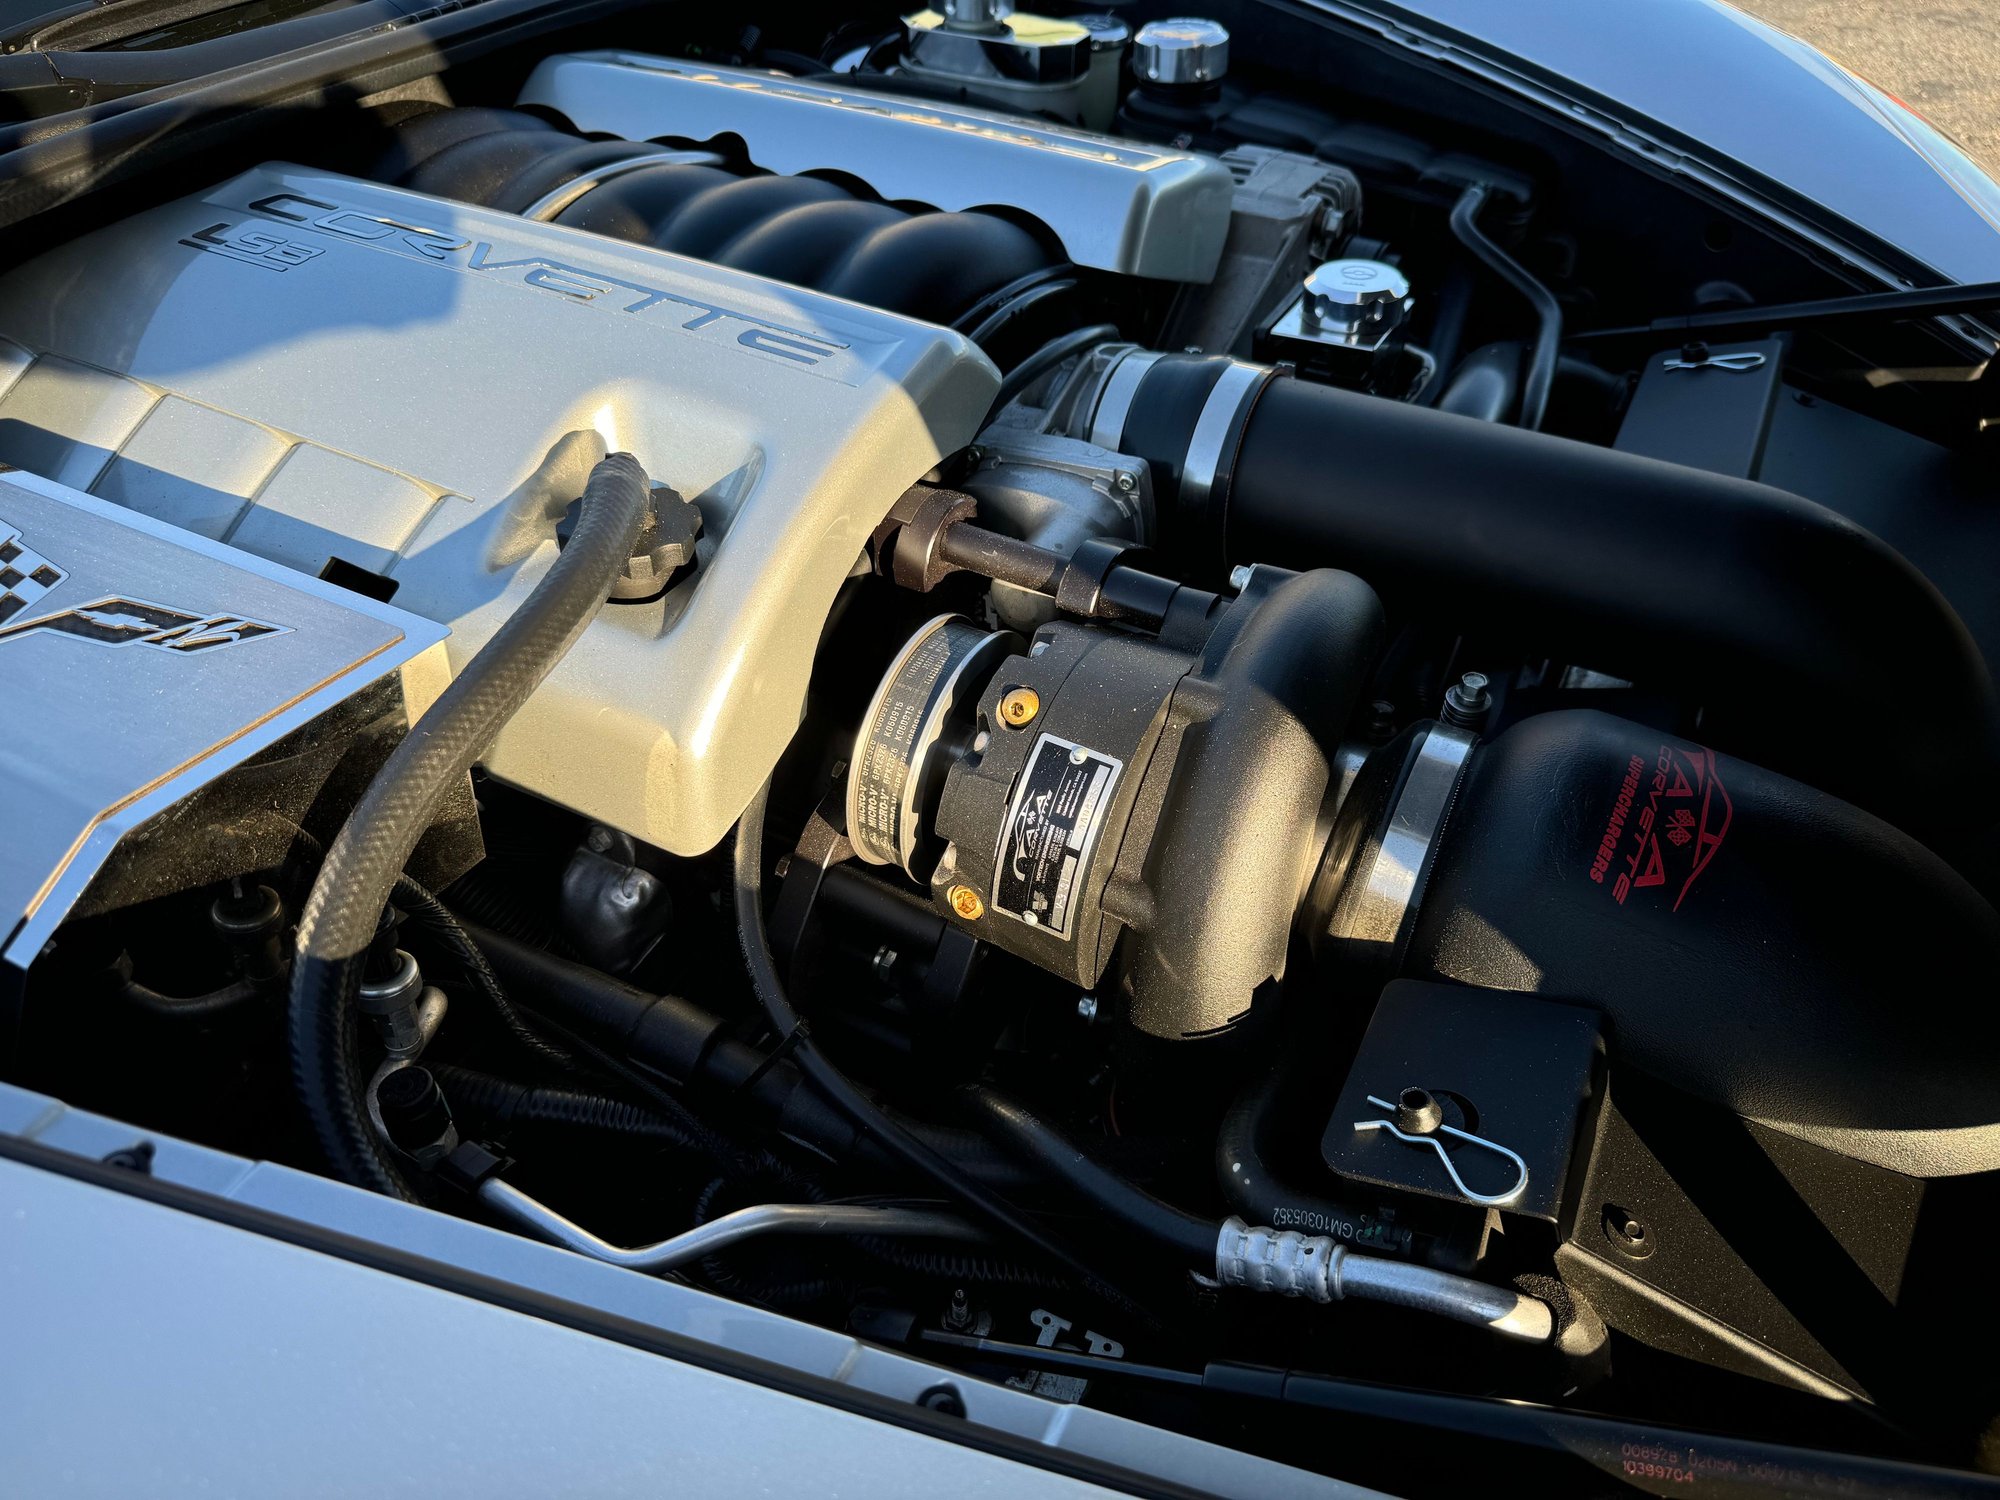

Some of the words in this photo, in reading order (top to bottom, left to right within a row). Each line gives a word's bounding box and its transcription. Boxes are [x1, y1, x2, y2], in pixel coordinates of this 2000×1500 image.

[178, 222, 327, 272] LS3
[249, 193, 851, 366] CORVETTE
[883, 748, 899, 785] 6PK2326
[895, 705, 915, 742] K060915
[884, 701, 904, 738] K060915
[1029, 789, 1052, 857] CORVETTE
[1589, 754, 1646, 884] SUPERCHARGERS
[1612, 744, 1672, 905] CORVETTE
[1273, 1207, 1353, 1239] GM10305352
[1622, 1460, 1694, 1484] 10399704
